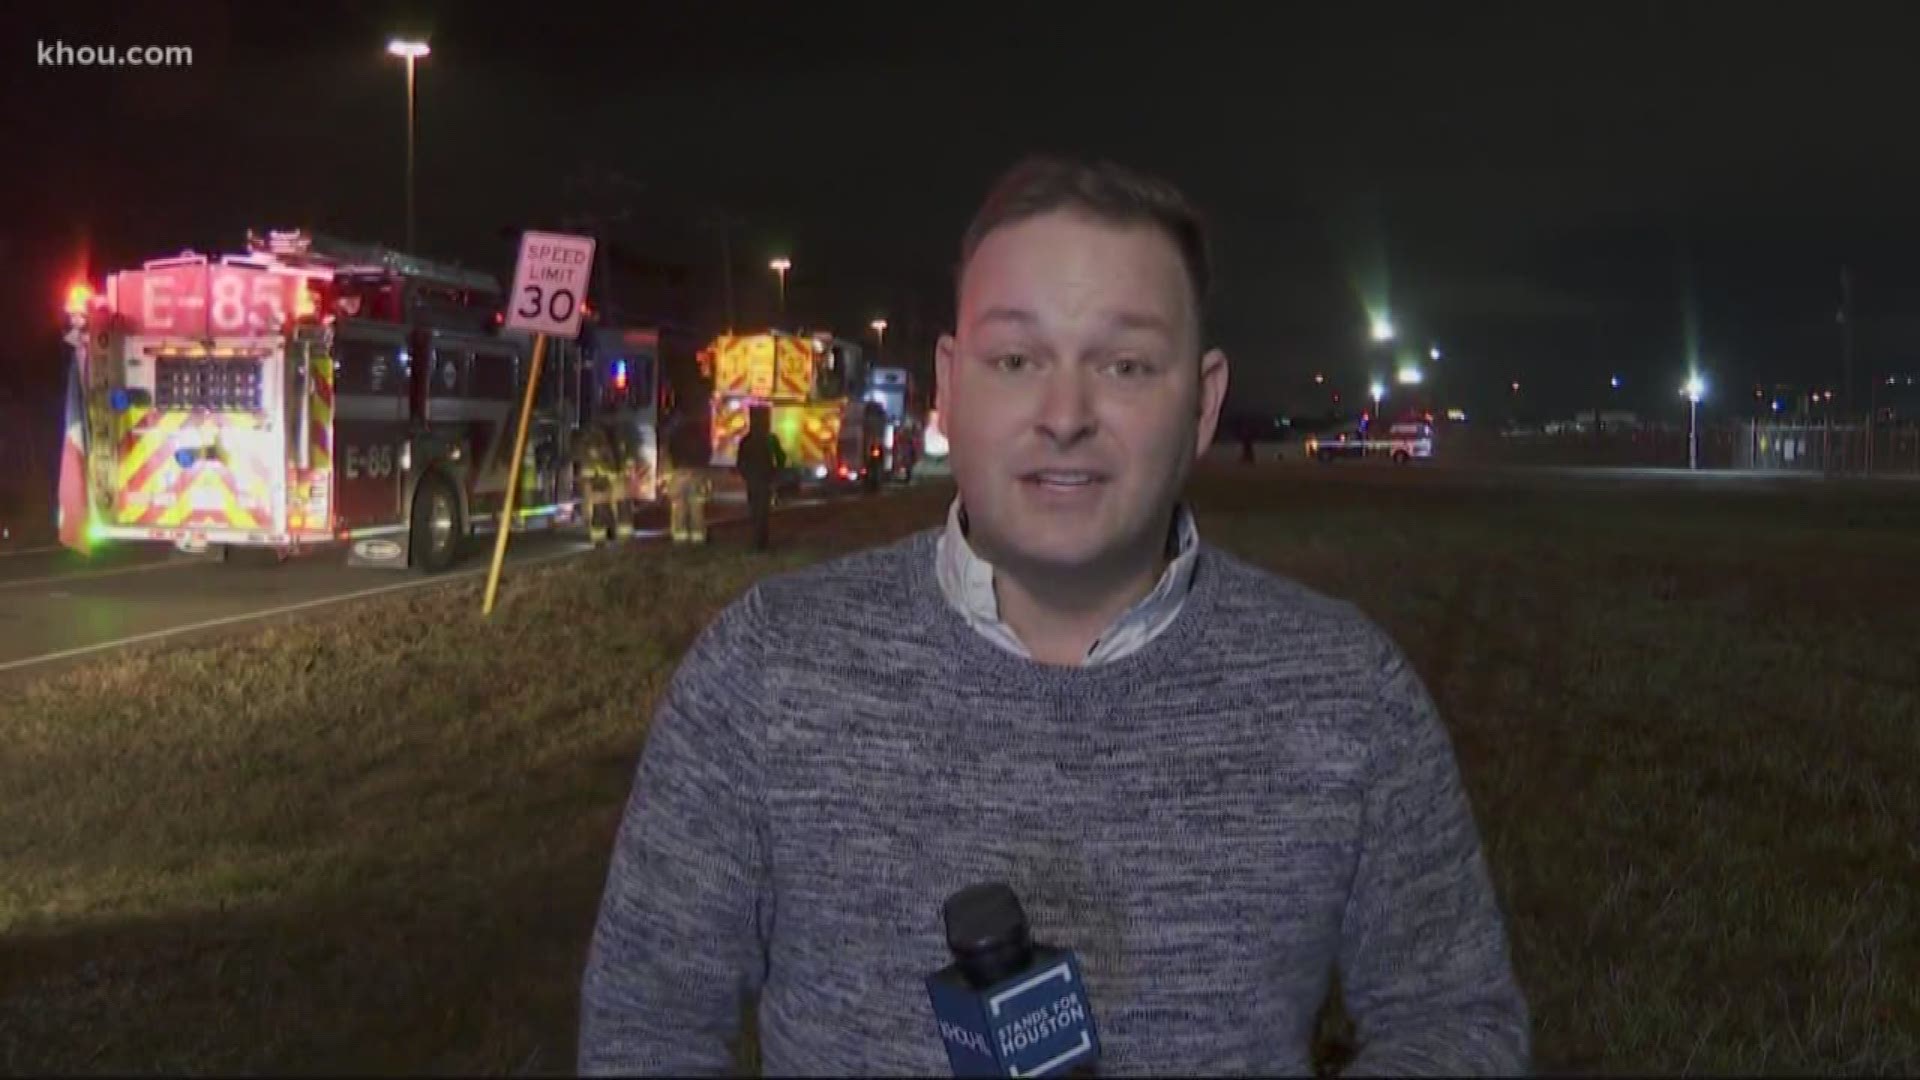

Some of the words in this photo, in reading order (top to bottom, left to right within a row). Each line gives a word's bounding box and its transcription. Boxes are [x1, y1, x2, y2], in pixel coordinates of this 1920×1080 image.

[528, 244, 586, 265] SPEED
[529, 263, 576, 283] LIMIT
[143, 274, 286, 332] E-85
[518, 285, 575, 323] 30
[345, 445, 393, 479] E-85
[998, 1006, 1049, 1042] STANDS
[1053, 992, 1080, 1016] FOR
[999, 1003, 1086, 1057] HOUSTON
